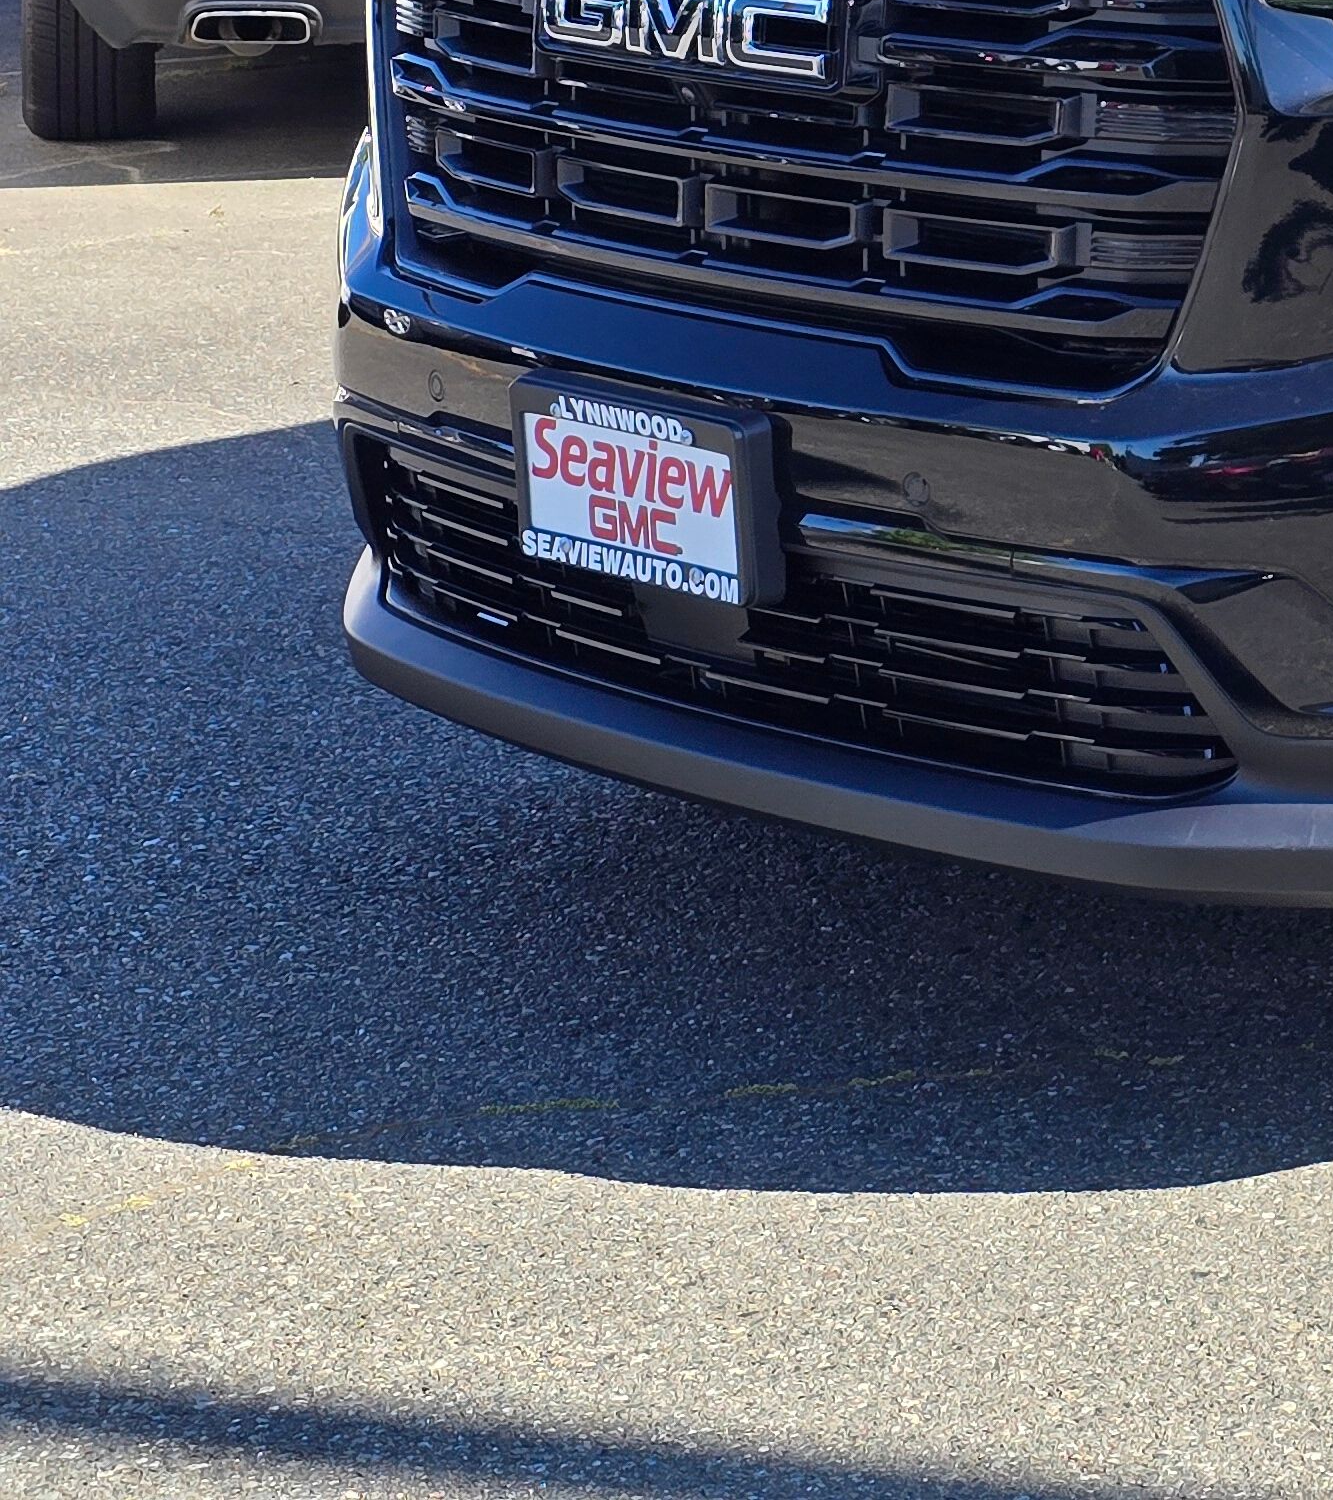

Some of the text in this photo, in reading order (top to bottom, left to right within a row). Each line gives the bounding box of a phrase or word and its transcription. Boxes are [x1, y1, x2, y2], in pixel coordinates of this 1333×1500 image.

[557, 395, 685, 444] LYNNWOOD
[531, 416, 734, 518] Seaview
[588, 493, 684, 557] GMC
[521, 529, 740, 606] SEAVIEWAUTO.COM
